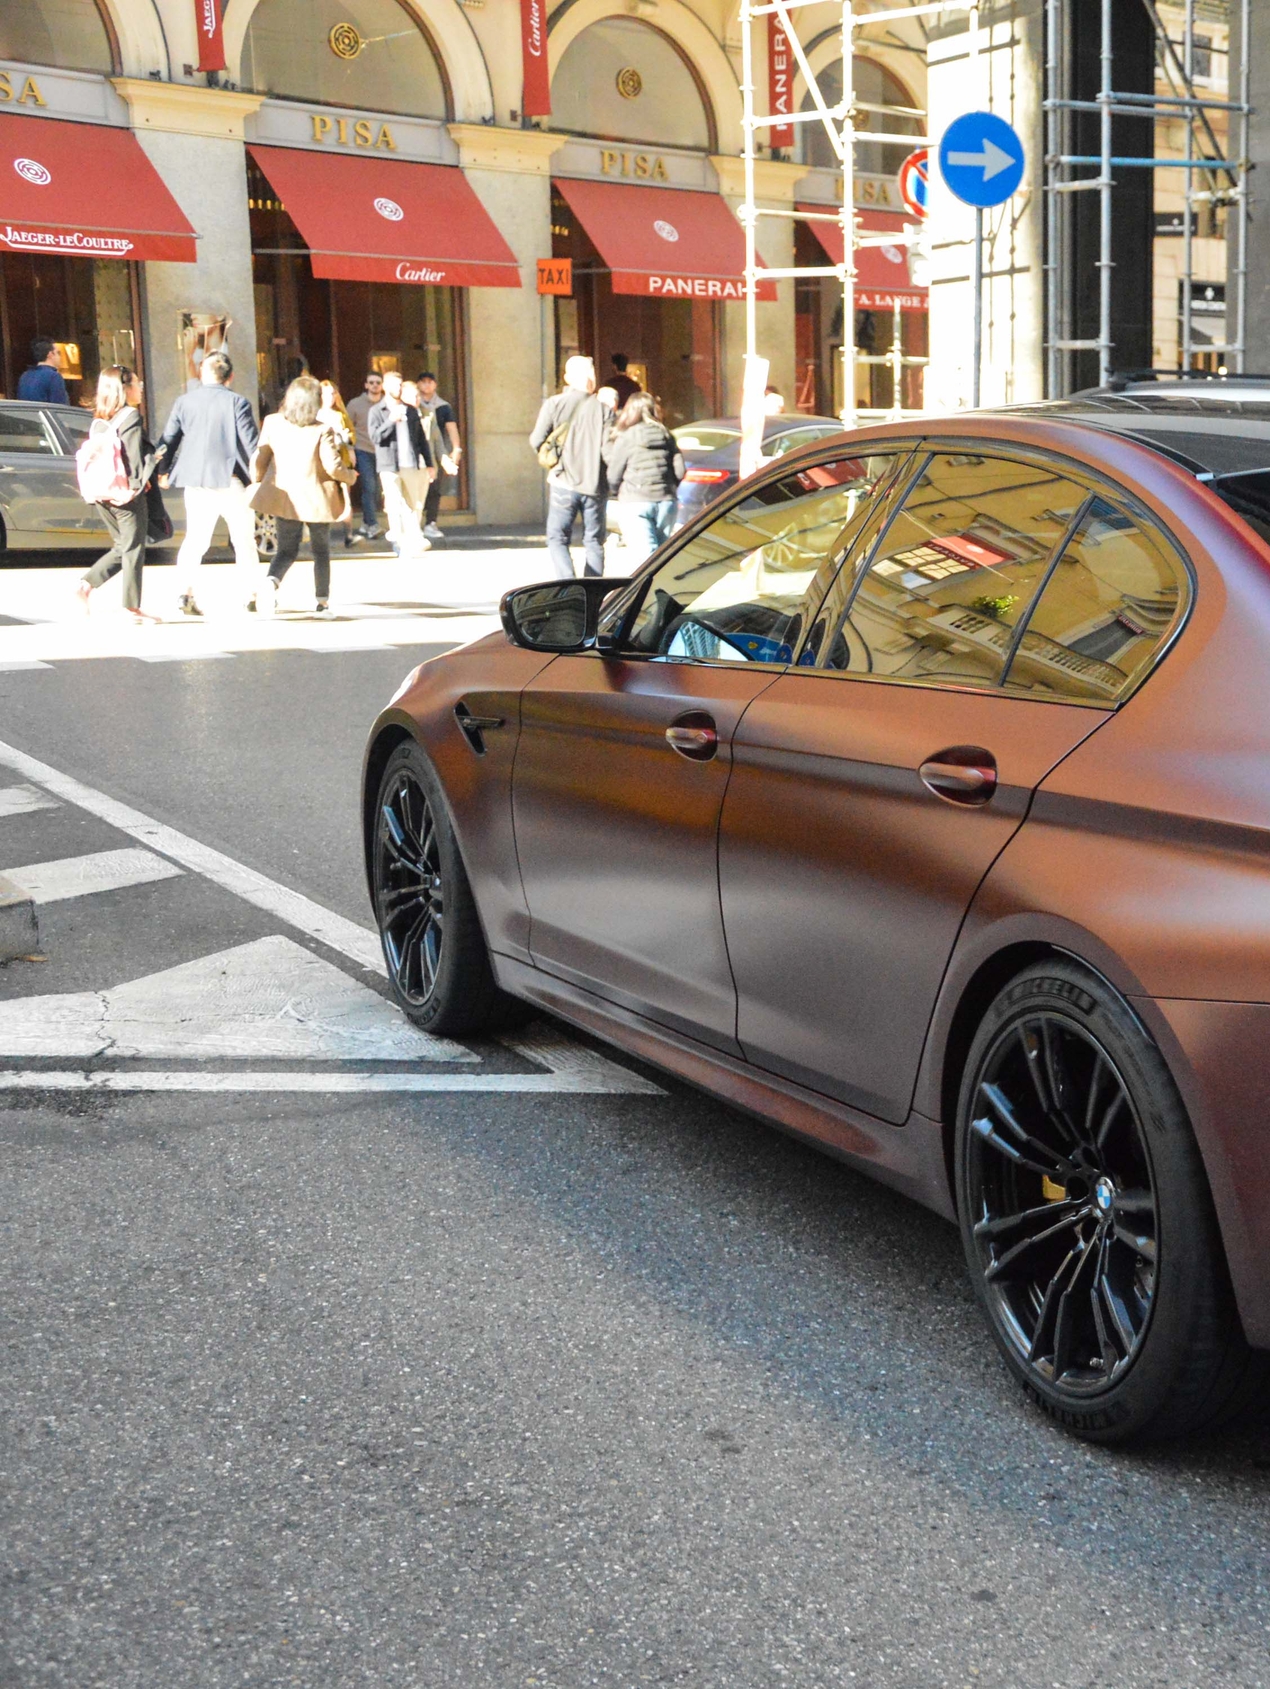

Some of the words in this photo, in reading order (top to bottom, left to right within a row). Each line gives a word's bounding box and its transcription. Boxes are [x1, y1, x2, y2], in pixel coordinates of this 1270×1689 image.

[311, 115, 396, 150] PISA
[601, 150, 670, 182] PISA
[395, 261, 446, 282] Cartier
[538, 268, 569, 286] TAXI
[649, 276, 743, 298] PANERAI
